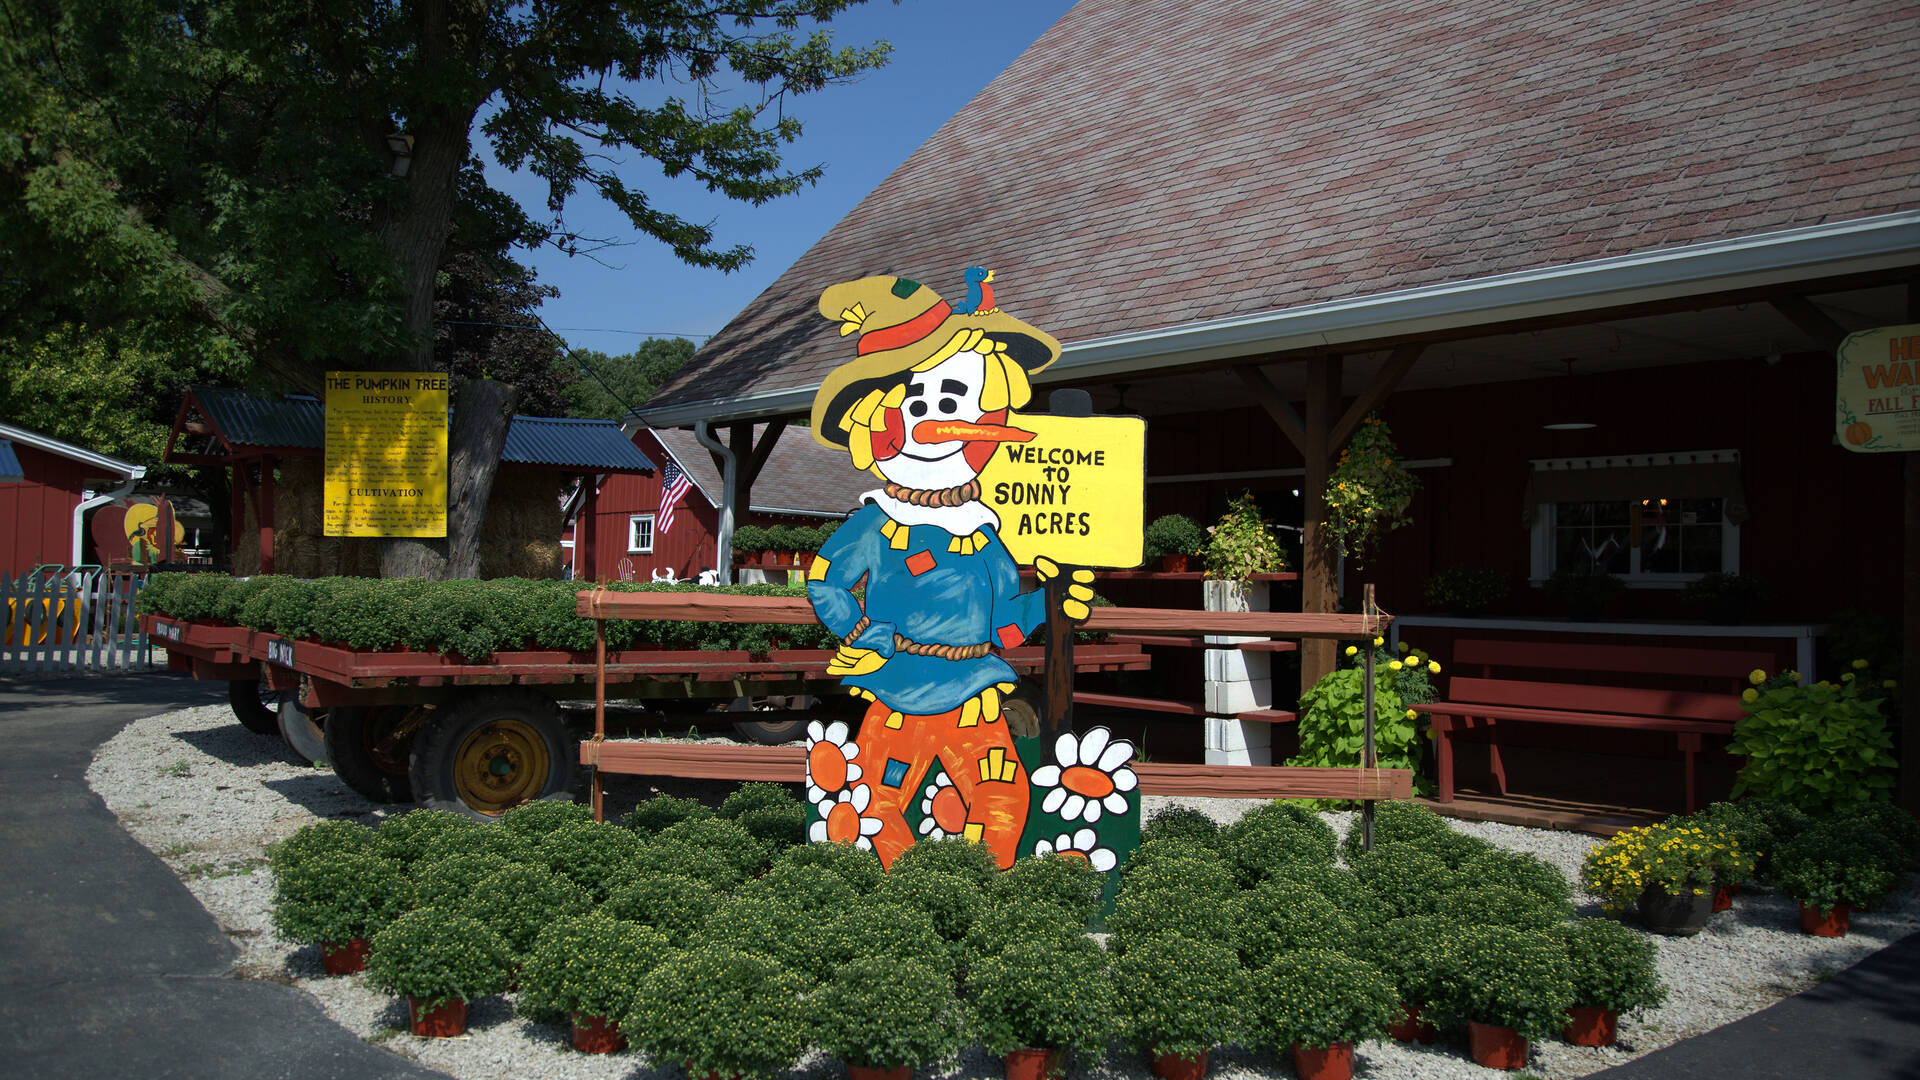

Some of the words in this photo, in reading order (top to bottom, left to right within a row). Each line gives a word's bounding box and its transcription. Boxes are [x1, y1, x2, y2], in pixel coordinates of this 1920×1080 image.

[327, 378, 350, 390] THE
[356, 378, 410, 390] PUMPKIN
[415, 378, 447, 391] TREE
[1862, 361, 1920, 389] WA
[363, 395, 411, 404] HISTORY
[1869, 397, 1904, 412] FALL
[1006, 444, 1105, 466] WELCOME
[1042, 466, 1070, 483] TO
[349, 488, 424, 497] CULTIVATION
[994, 482, 1071, 505] SONNY
[1018, 512, 1090, 536] ACRES
[268, 640, 278, 660] BIG
[279, 643, 293, 667] NICK
